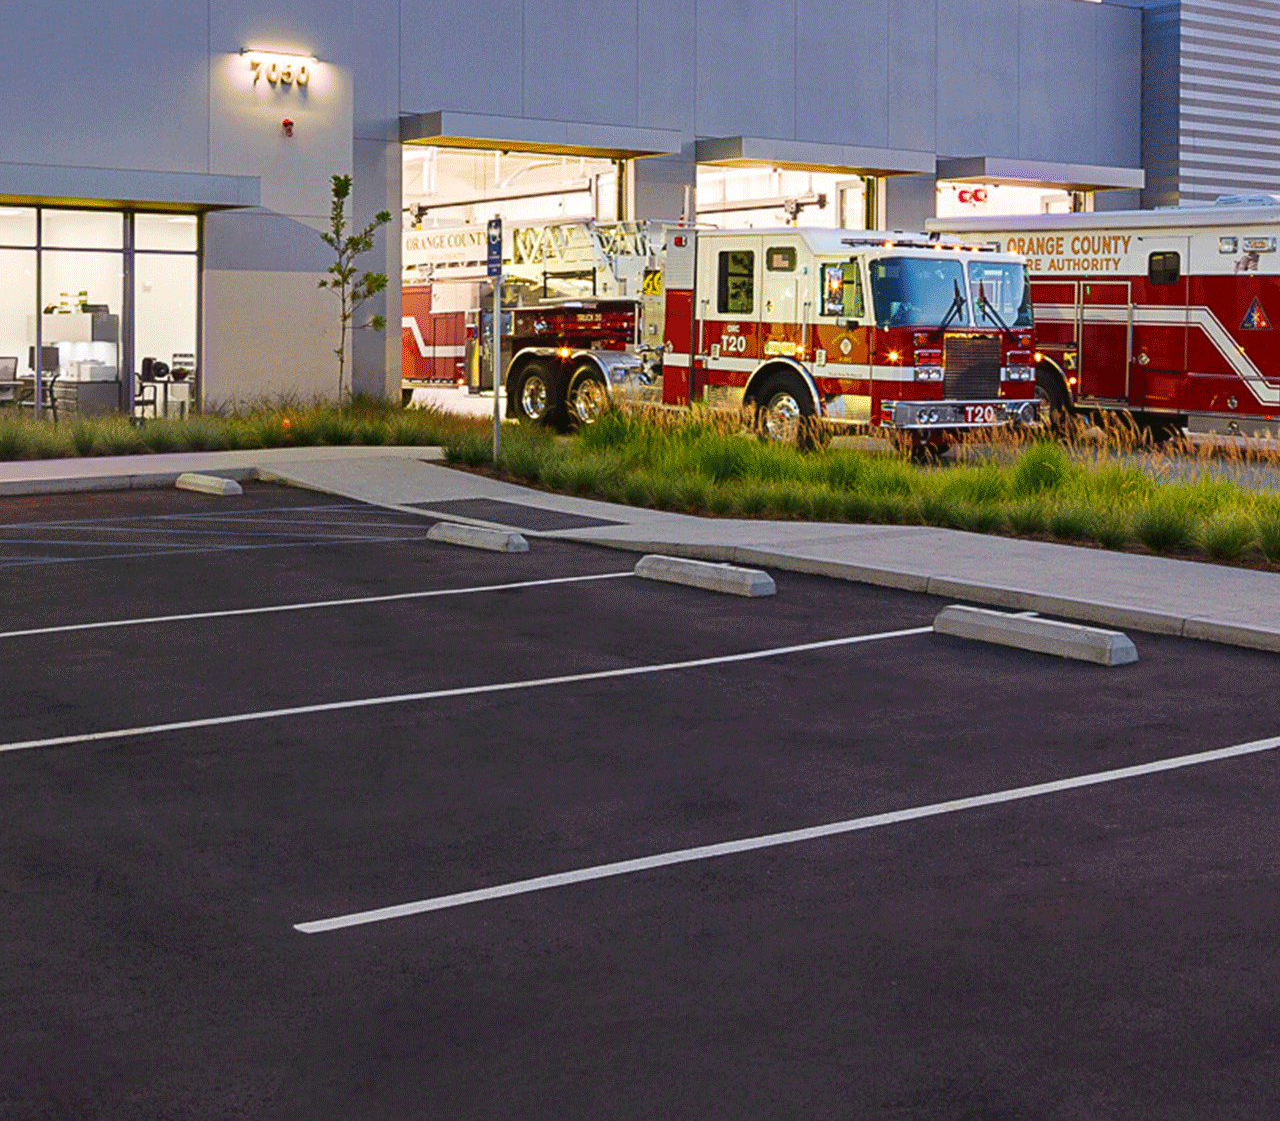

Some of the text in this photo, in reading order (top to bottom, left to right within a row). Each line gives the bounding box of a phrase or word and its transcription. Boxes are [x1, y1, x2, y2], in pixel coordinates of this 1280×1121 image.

[406, 235, 446, 251] ORANGE
[1007, 235, 1131, 255] ORANGE COUNTY
[1026, 258, 1121, 271] RE AUTHORITY
[721, 335, 746, 352] T20
[965, 406, 994, 422] T20
